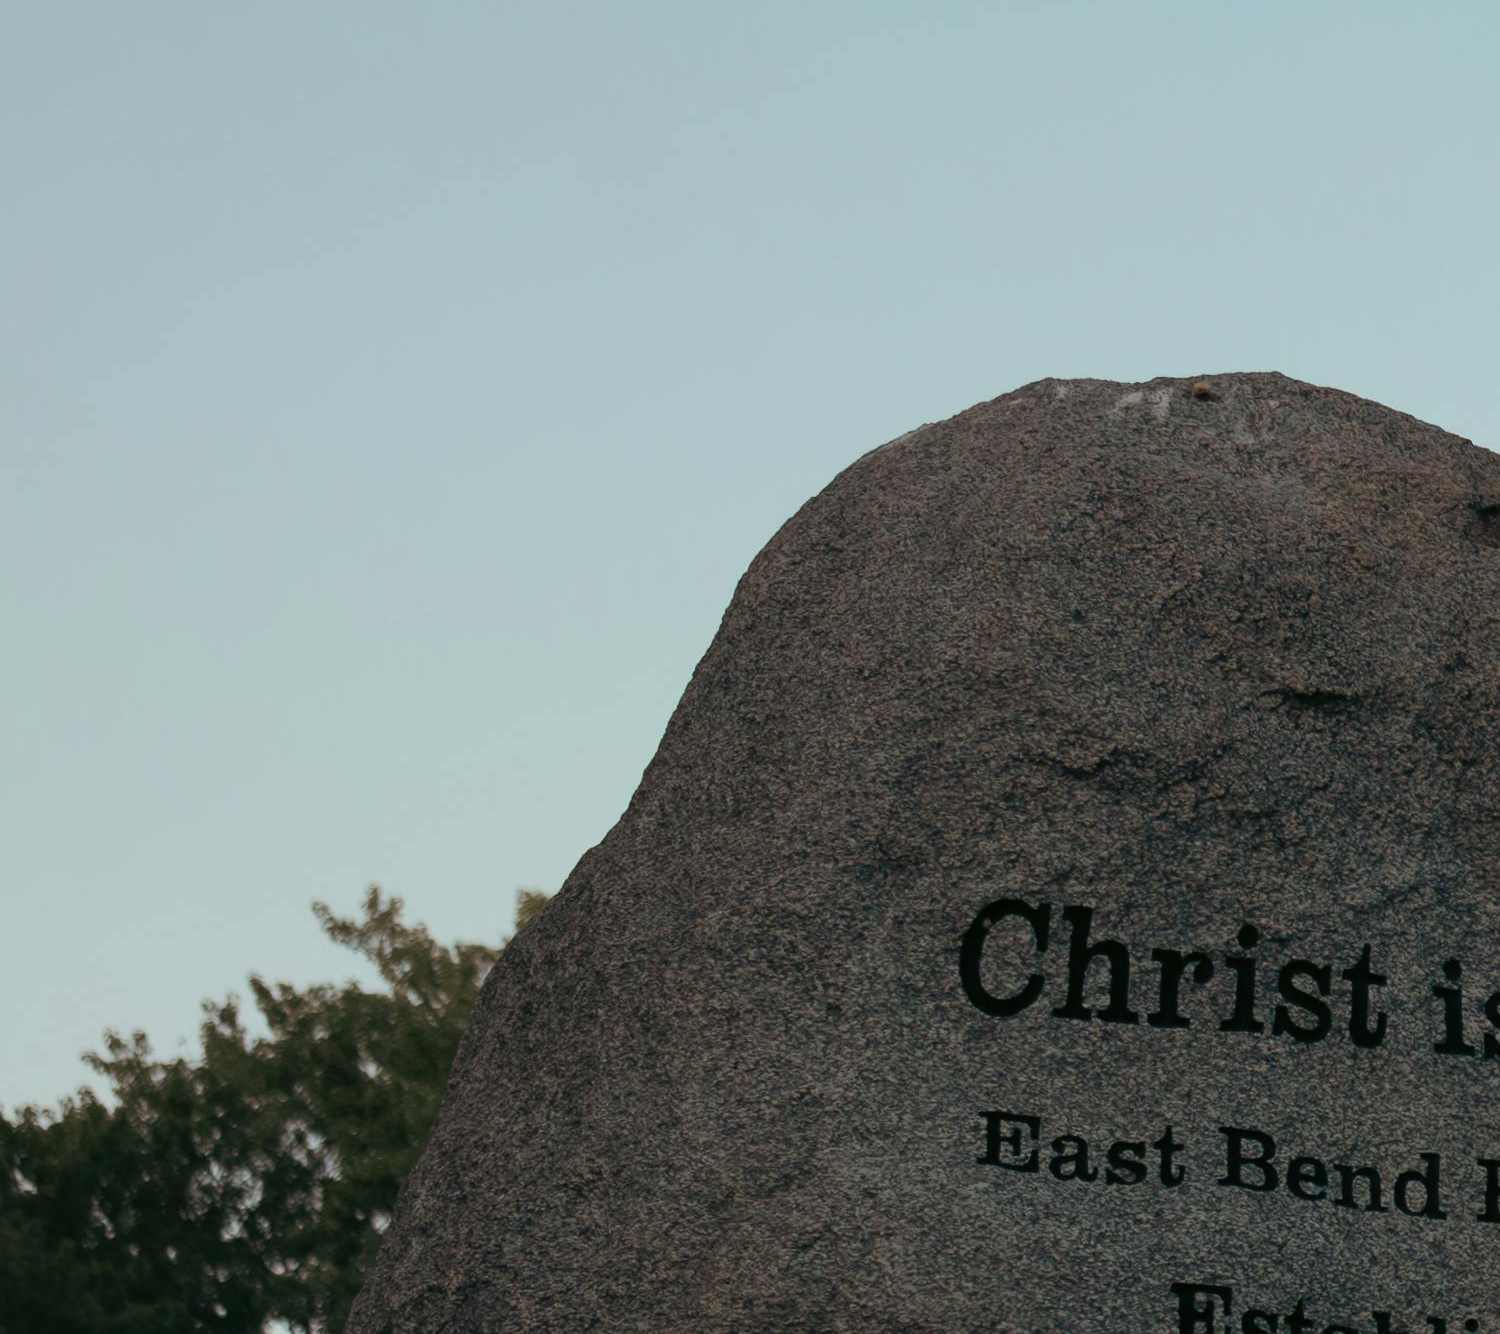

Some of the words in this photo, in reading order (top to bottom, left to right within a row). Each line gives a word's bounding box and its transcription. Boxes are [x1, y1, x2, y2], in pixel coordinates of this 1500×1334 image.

[955, 895, 1389, 1051] Christ
[976, 1109, 1187, 1189] East
[1217, 1125, 1447, 1222] Bend
